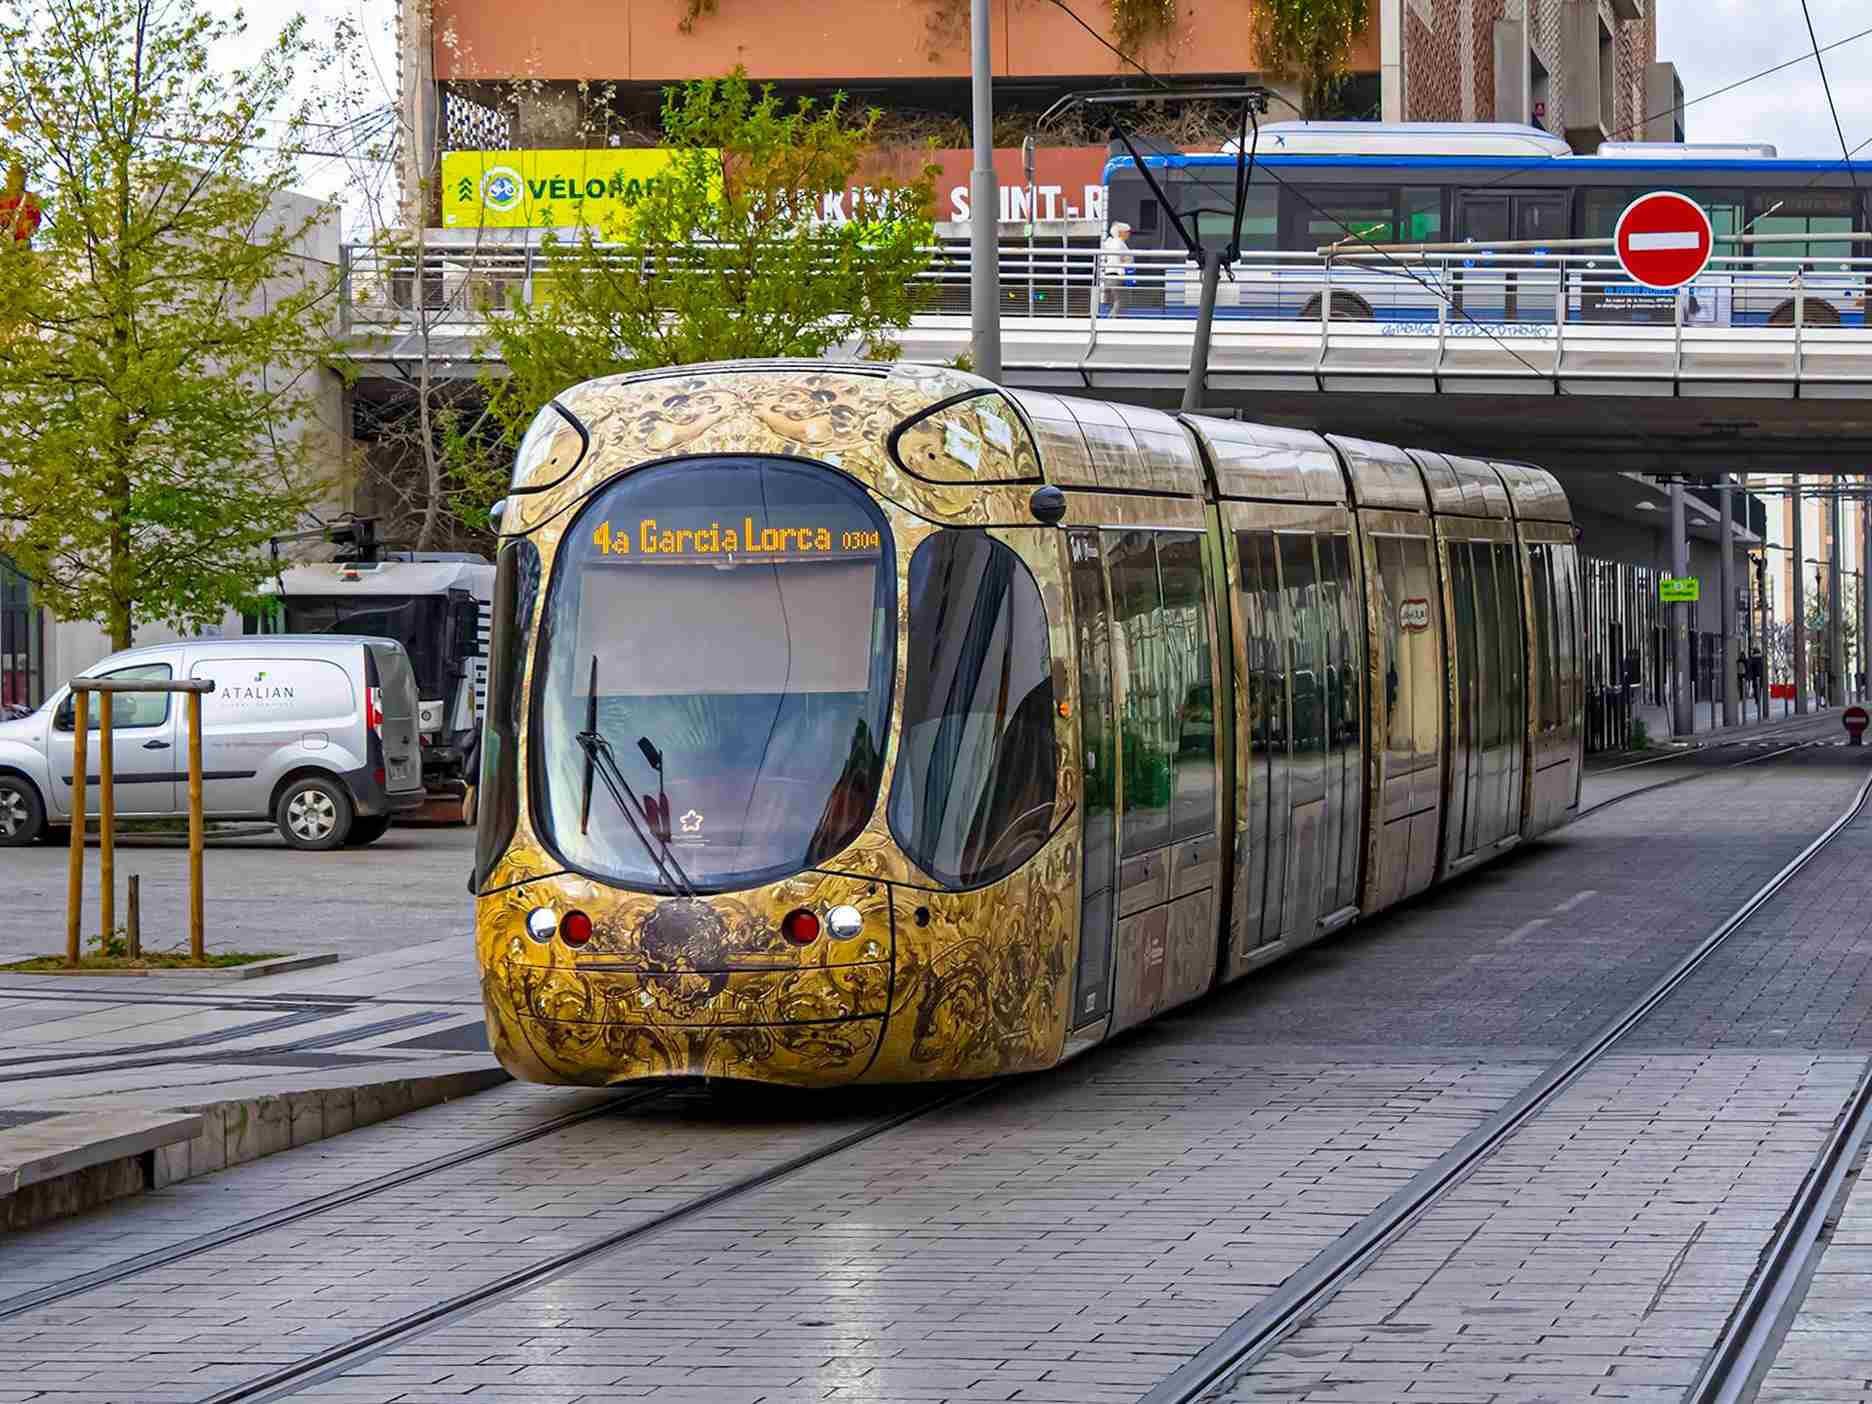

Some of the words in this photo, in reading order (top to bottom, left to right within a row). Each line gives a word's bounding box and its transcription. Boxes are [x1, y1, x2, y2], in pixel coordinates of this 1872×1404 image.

[593, 520, 629, 554] 4a
[744, 517, 832, 552] Lorca
[842, 530, 880, 551] 0304
[222, 687, 295, 699] ATALIAN
